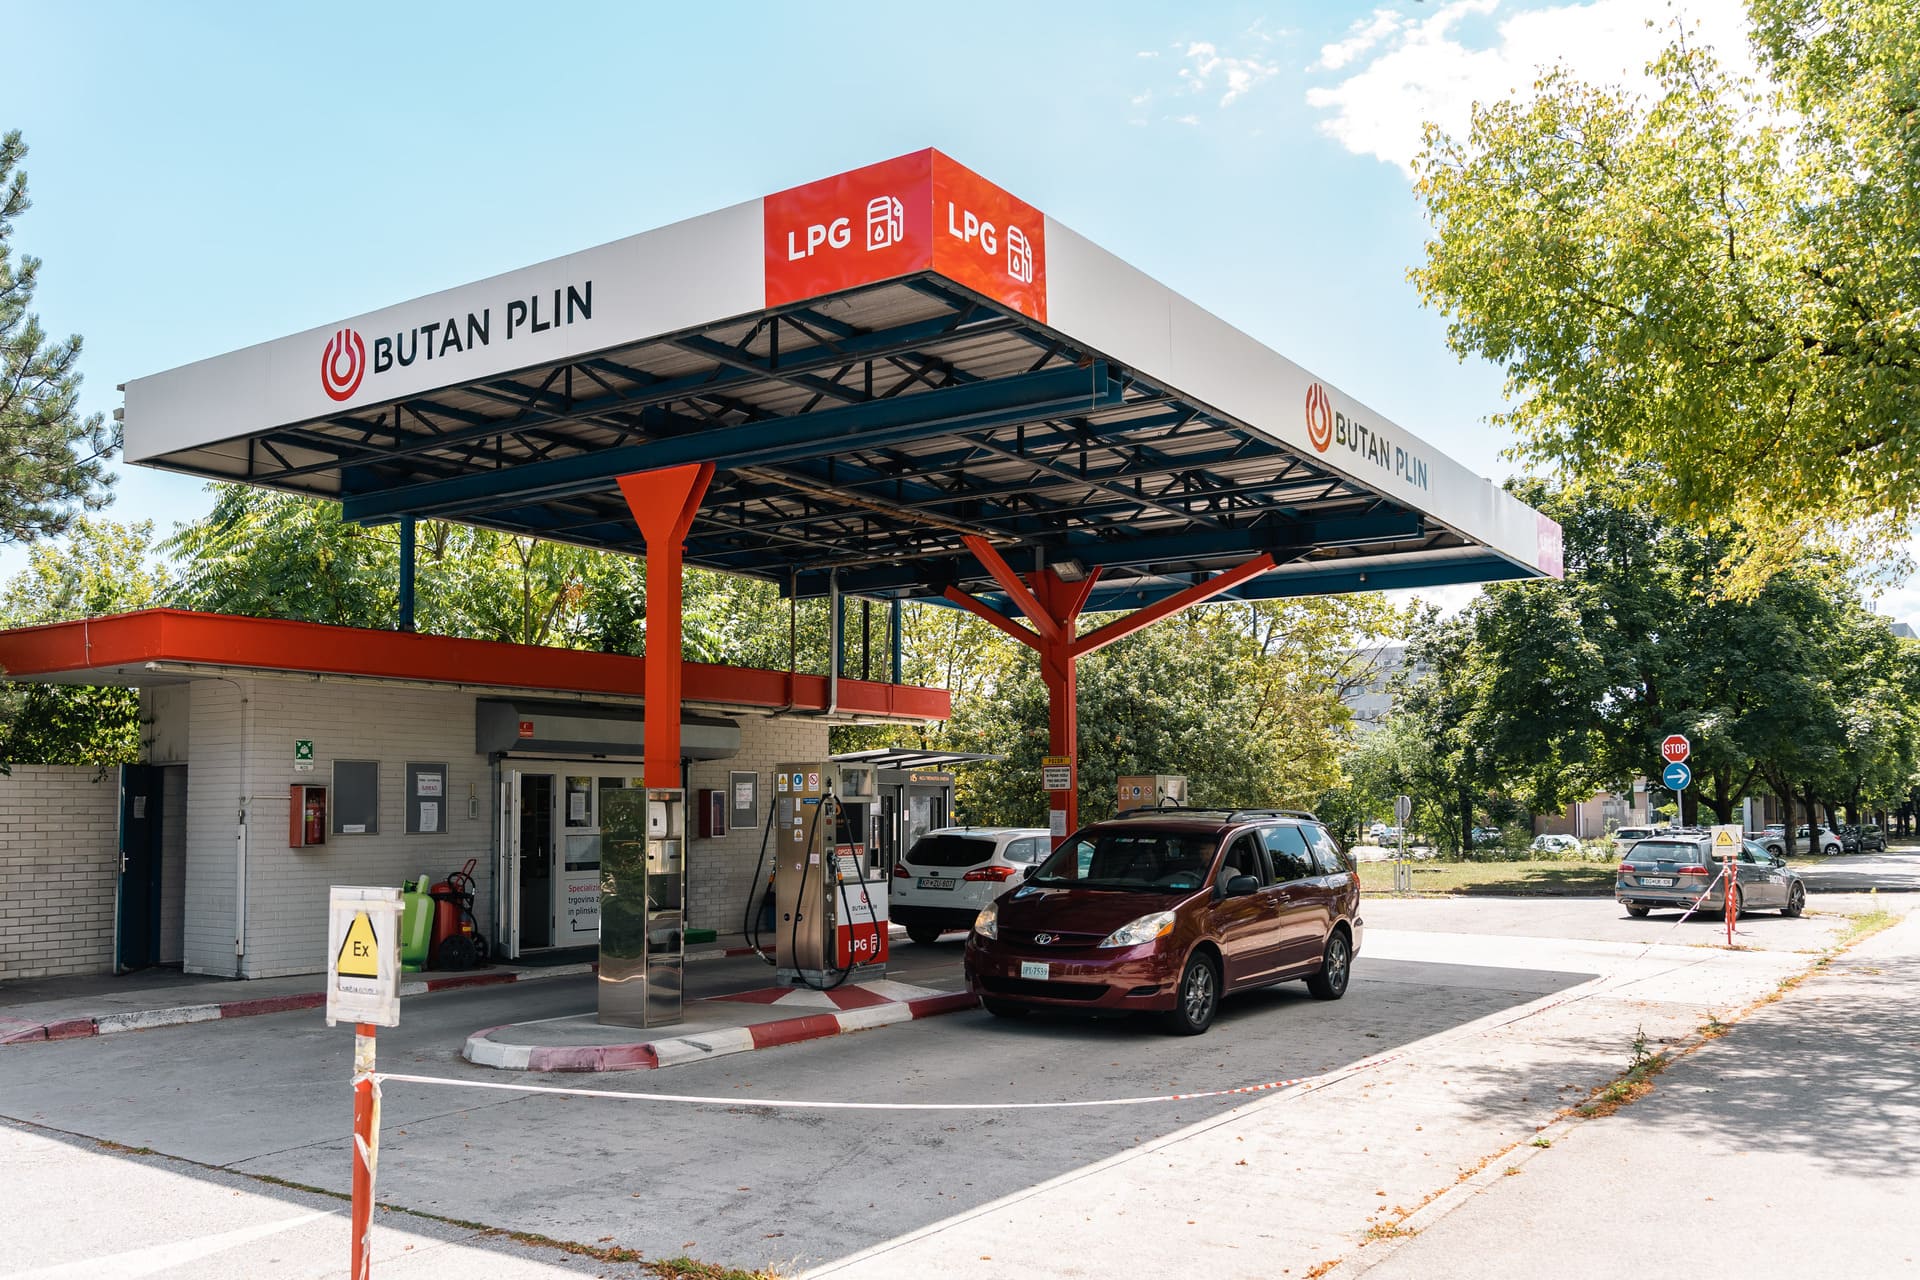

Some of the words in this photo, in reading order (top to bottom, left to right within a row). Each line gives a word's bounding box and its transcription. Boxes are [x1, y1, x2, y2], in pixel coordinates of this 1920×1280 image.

[948, 201, 997, 256] LPG
[788, 217, 850, 261] LPG
[374, 309, 490, 374] BUTAN
[507, 281, 592, 340] PLIN
[1335, 411, 1390, 471] BUTAN
[1396, 446, 1427, 492] PLIN
[1664, 743, 1687, 755] STOP
[568, 896, 595, 905] trgovina
[575, 906, 598, 916] plinske
[353, 940, 370, 958] Ex
[848, 938, 868, 953] LPG
